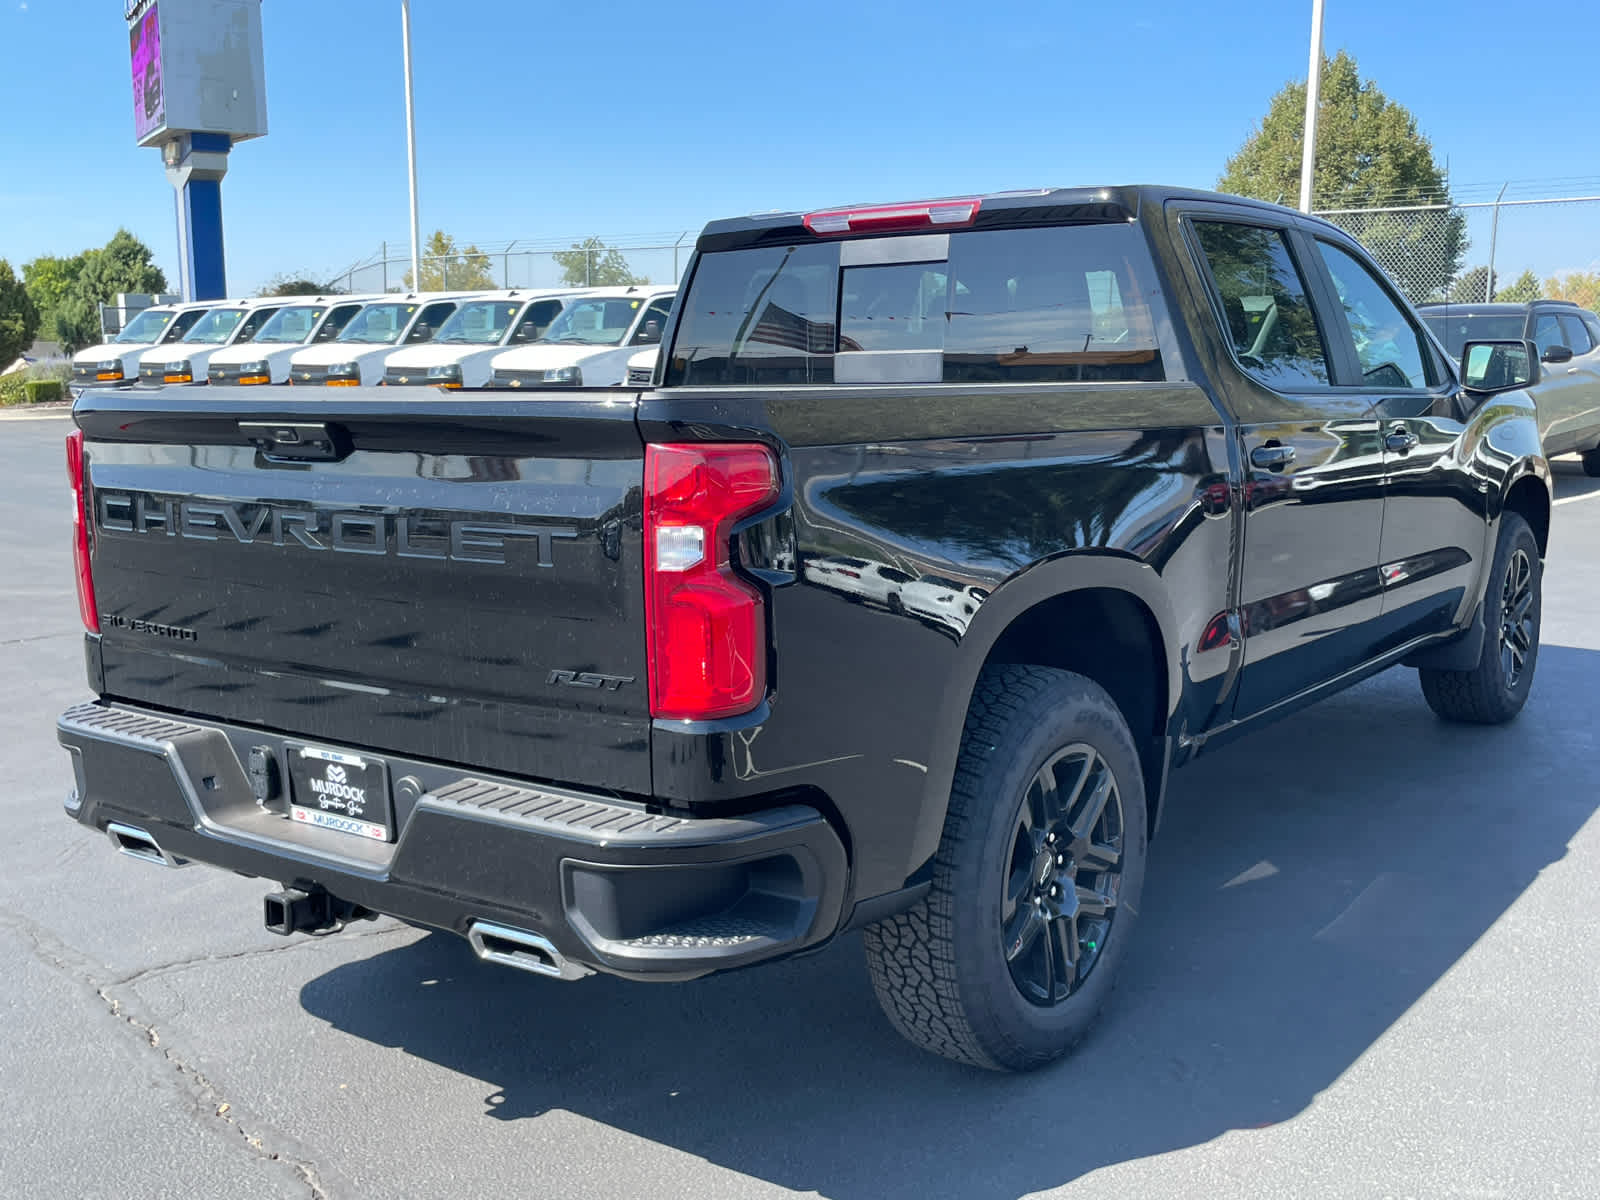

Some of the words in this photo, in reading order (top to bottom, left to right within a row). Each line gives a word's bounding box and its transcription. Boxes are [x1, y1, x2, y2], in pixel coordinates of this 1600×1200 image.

[101, 499, 578, 567] CHEVROLET
[103, 614, 198, 641] SILVERADO
[544, 669, 635, 691] RST
[310, 778, 366, 804] MURDOCK
[313, 814, 363, 833] MURDOCK
